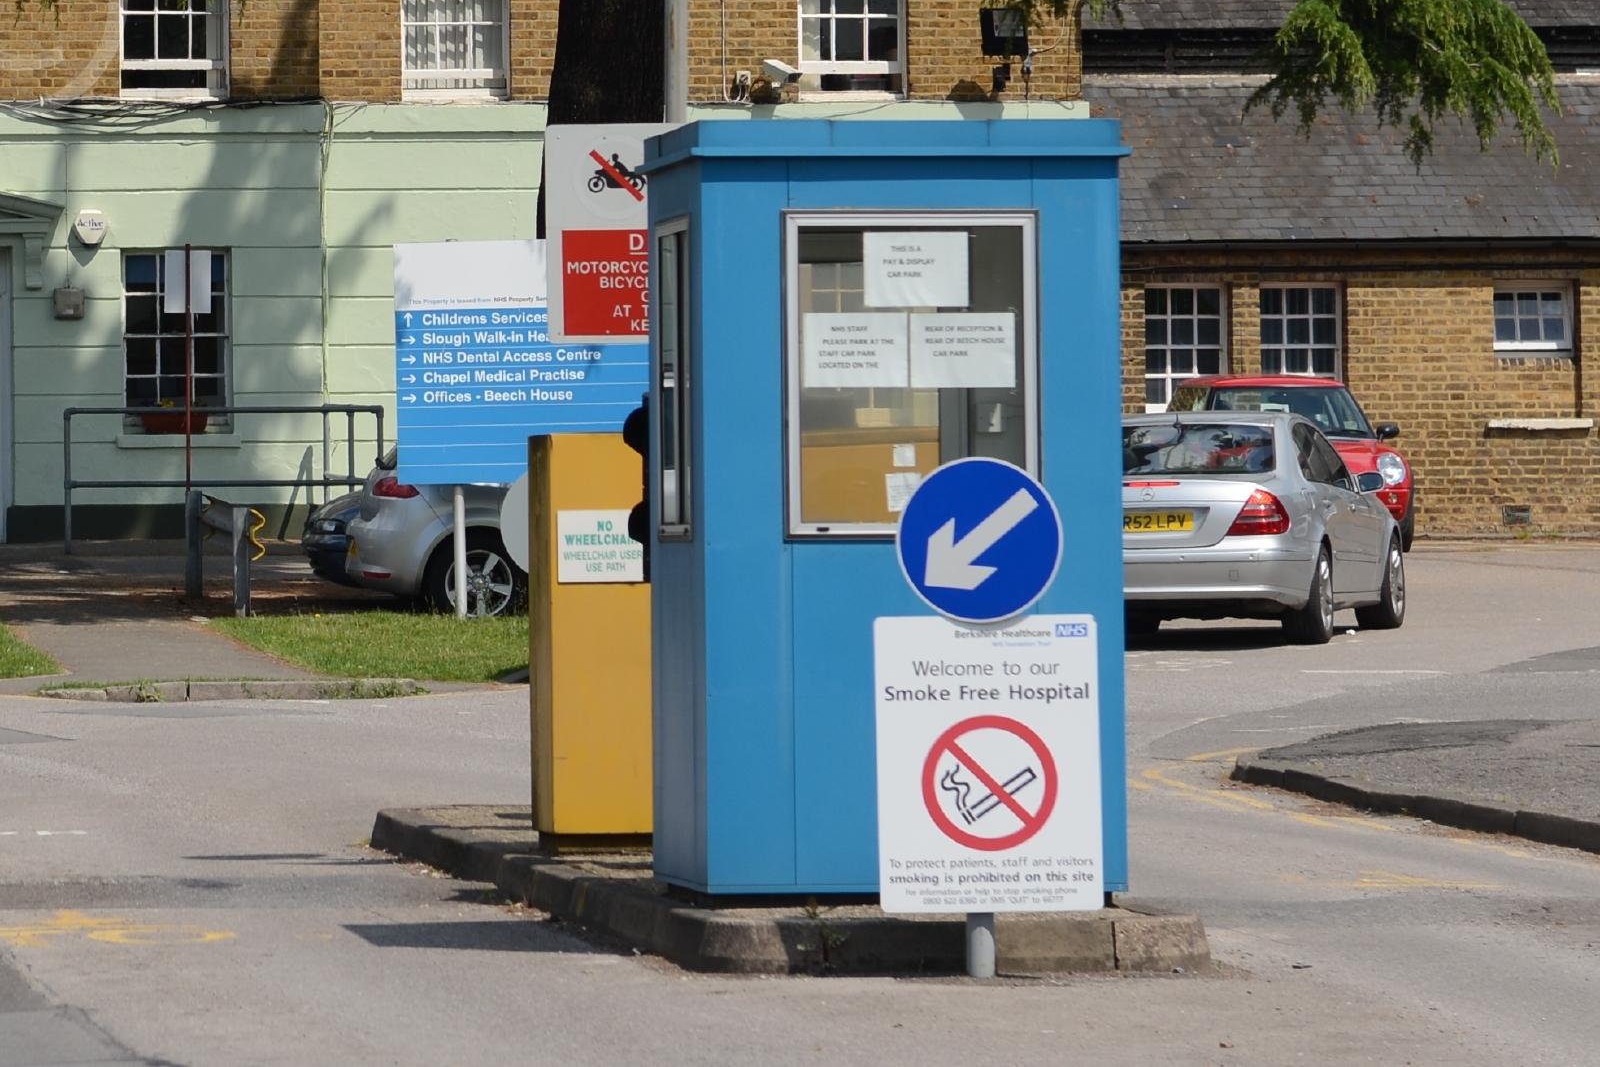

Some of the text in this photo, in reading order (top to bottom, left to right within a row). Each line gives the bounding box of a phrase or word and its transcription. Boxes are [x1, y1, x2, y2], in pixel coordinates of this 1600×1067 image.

[567, 261, 649, 274] MOTORCYC
[613, 305, 631, 317] AT
[422, 312, 548, 326] Childrens Services
[422, 333, 470, 347] Slough
[474, 331, 523, 343] Walk-in
[423, 349, 601, 364] NHS Dental Access Centre
[423, 369, 585, 385] Chapel Medical Practise
[423, 391, 472, 403] Offices
[484, 390, 526, 402] Beech
[530, 389, 573, 400] House
[597, 521, 613, 532] NO
[1123, 515, 1152, 529] R52
[564, 534, 636, 545] WHEELCHA
[563, 551, 617, 560] WHEELCHAIR
[586, 562, 625, 572] USE PATH
[954, 630, 998, 638] Berkshire
[1055, 623, 1088, 637] NHS
[912, 660, 1060, 676] Welcome to our
[884, 682, 1089, 704] Smoke Free Hospital
[889, 859, 901, 868] To
[906, 859, 945, 869] protect
[1002, 857, 1027, 867] staff
[1032, 857, 1052, 866] and
[1056, 856, 1093, 866] visitors
[889, 871, 1094, 886] smoking is prohibited on this site
